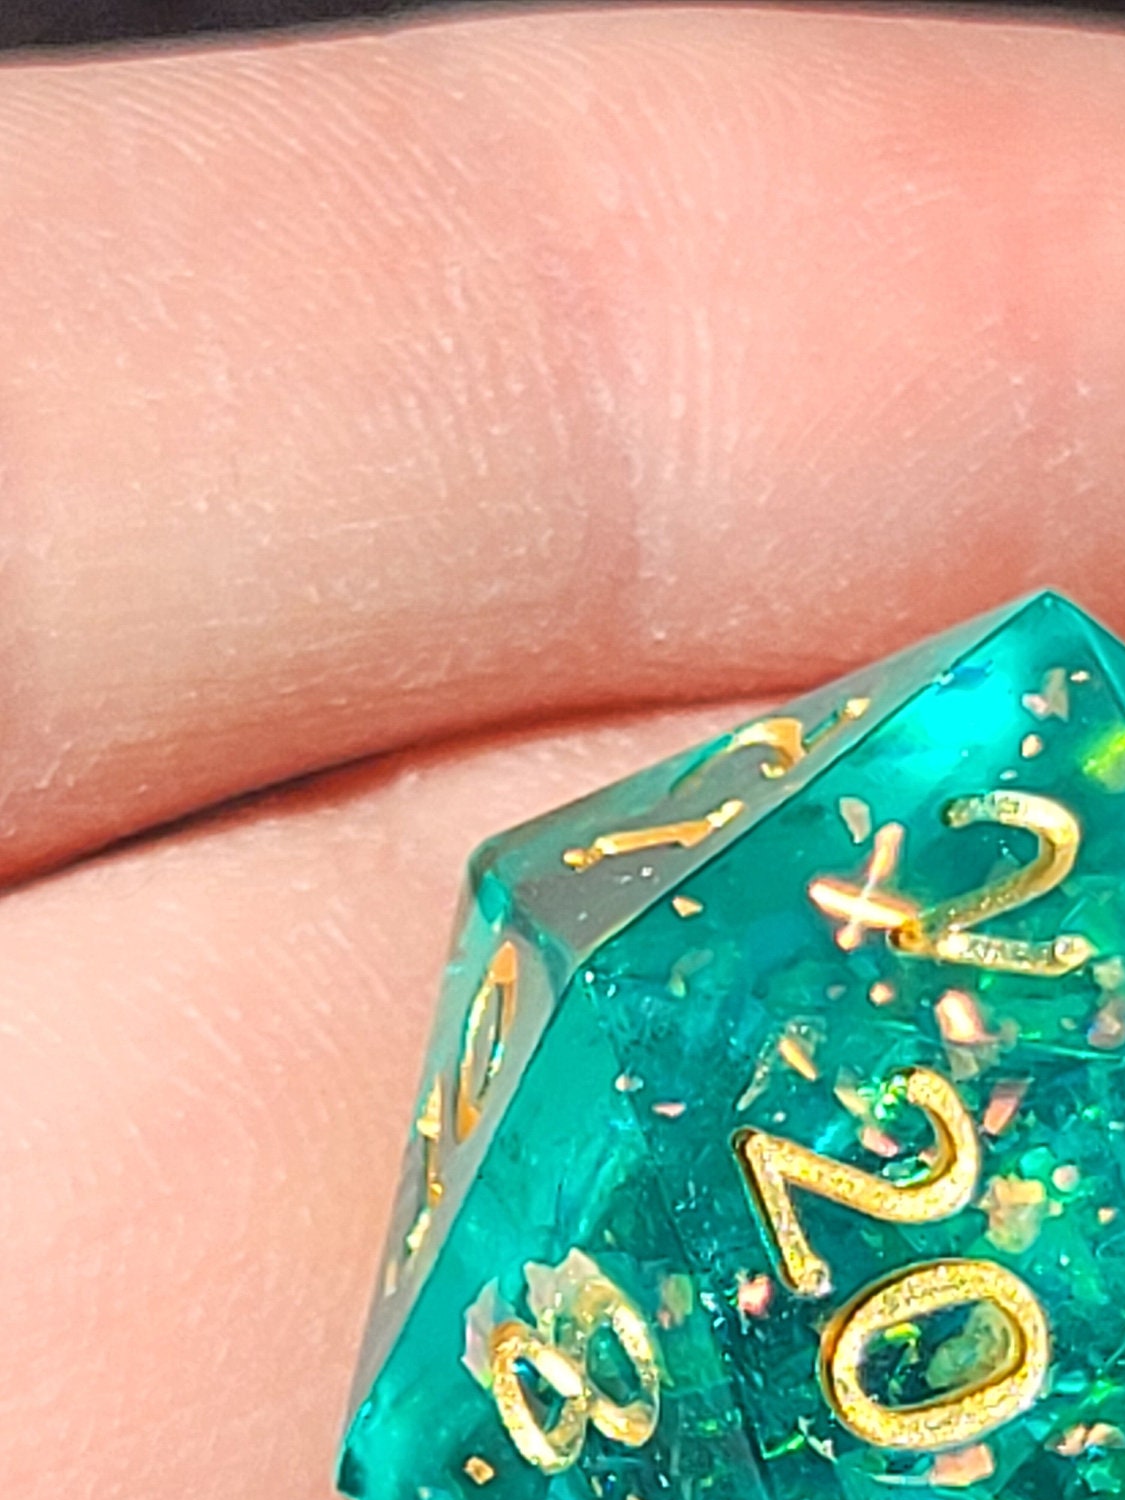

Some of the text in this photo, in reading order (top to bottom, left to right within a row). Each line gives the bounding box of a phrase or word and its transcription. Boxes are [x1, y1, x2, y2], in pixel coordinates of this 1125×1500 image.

[890, 790, 1094, 976] 2
[731, 1066, 1050, 1450] 20
[490, 1278, 660, 1474] 8
